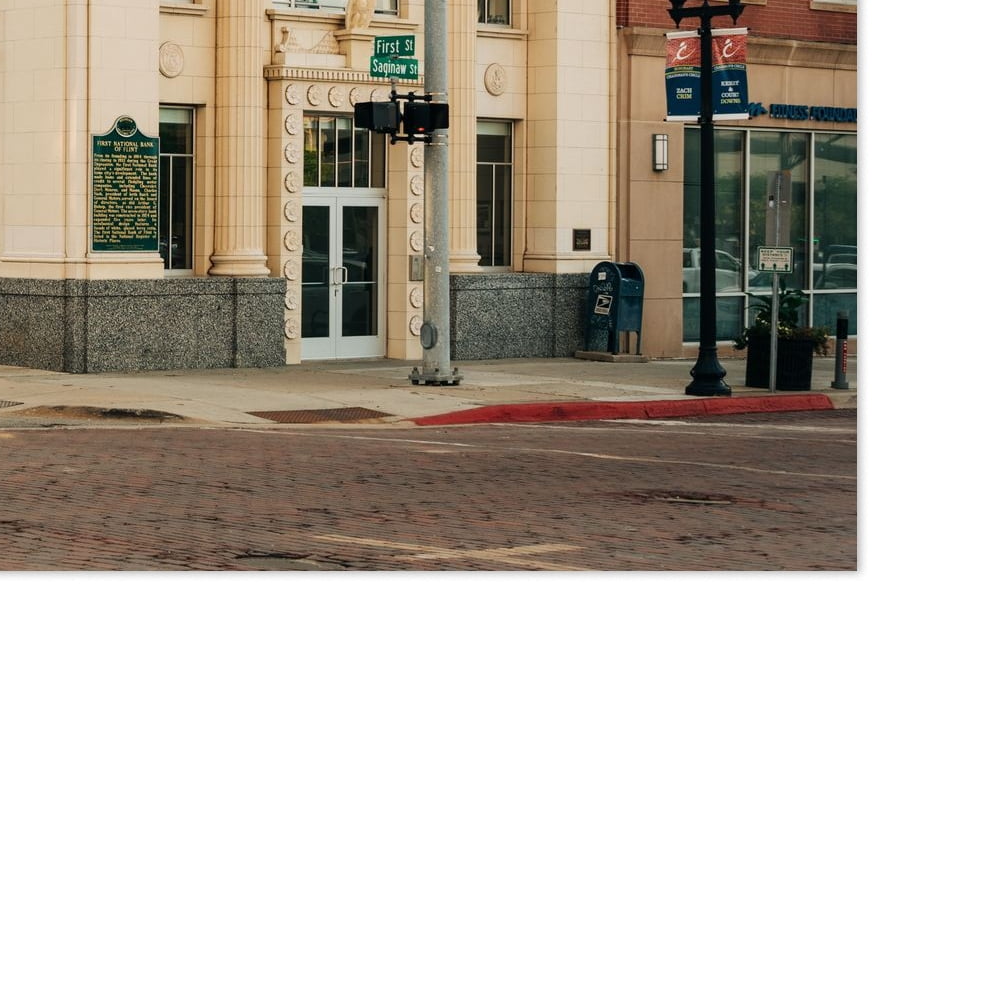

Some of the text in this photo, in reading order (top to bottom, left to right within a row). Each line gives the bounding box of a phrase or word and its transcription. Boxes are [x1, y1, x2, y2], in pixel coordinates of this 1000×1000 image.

[376, 39, 413, 54] First St
[372, 59, 417, 77] Saginaw St
